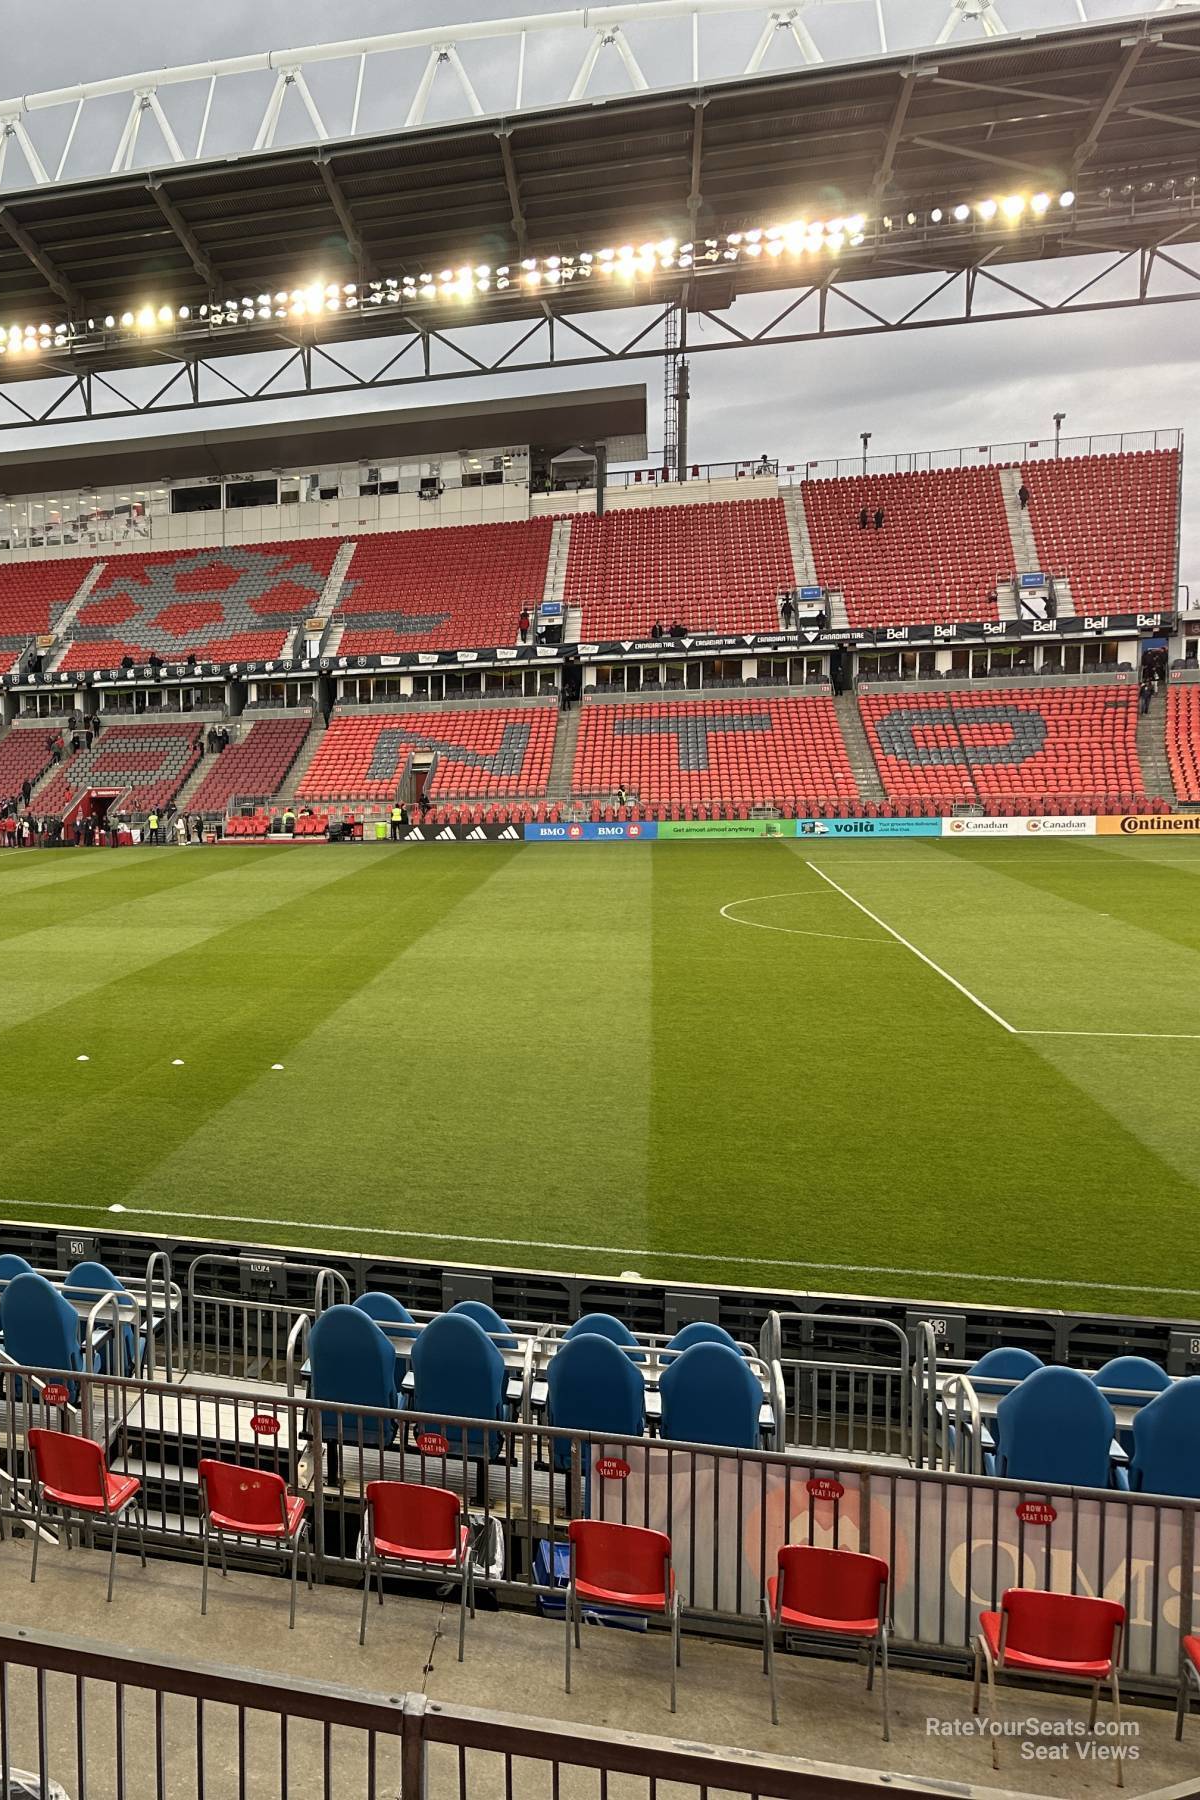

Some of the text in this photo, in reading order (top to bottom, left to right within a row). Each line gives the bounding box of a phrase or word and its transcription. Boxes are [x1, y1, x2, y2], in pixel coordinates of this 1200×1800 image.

[1033, 619, 1057, 632] Bell
[1084, 617, 1108, 630] Bell
[1137, 614, 1161, 627] Bell
[934, 625, 957, 637] Bell
[983, 622, 1006, 634] Bell
[887, 628, 909, 640] Bell
[834, 821, 875, 832] voilà
[966, 820, 1009, 829] Canadian
[1042, 819, 1087, 829] Canadian
[540, 828, 565, 836] BMO
[598, 827, 624, 835] BMO
[70, 1241, 84, 1255] 50
[600, 1468, 614, 1476] SEAT
[811, 1488, 826, 1496] SEAT
[1022, 1512, 1053, 1522] SEAT 103
